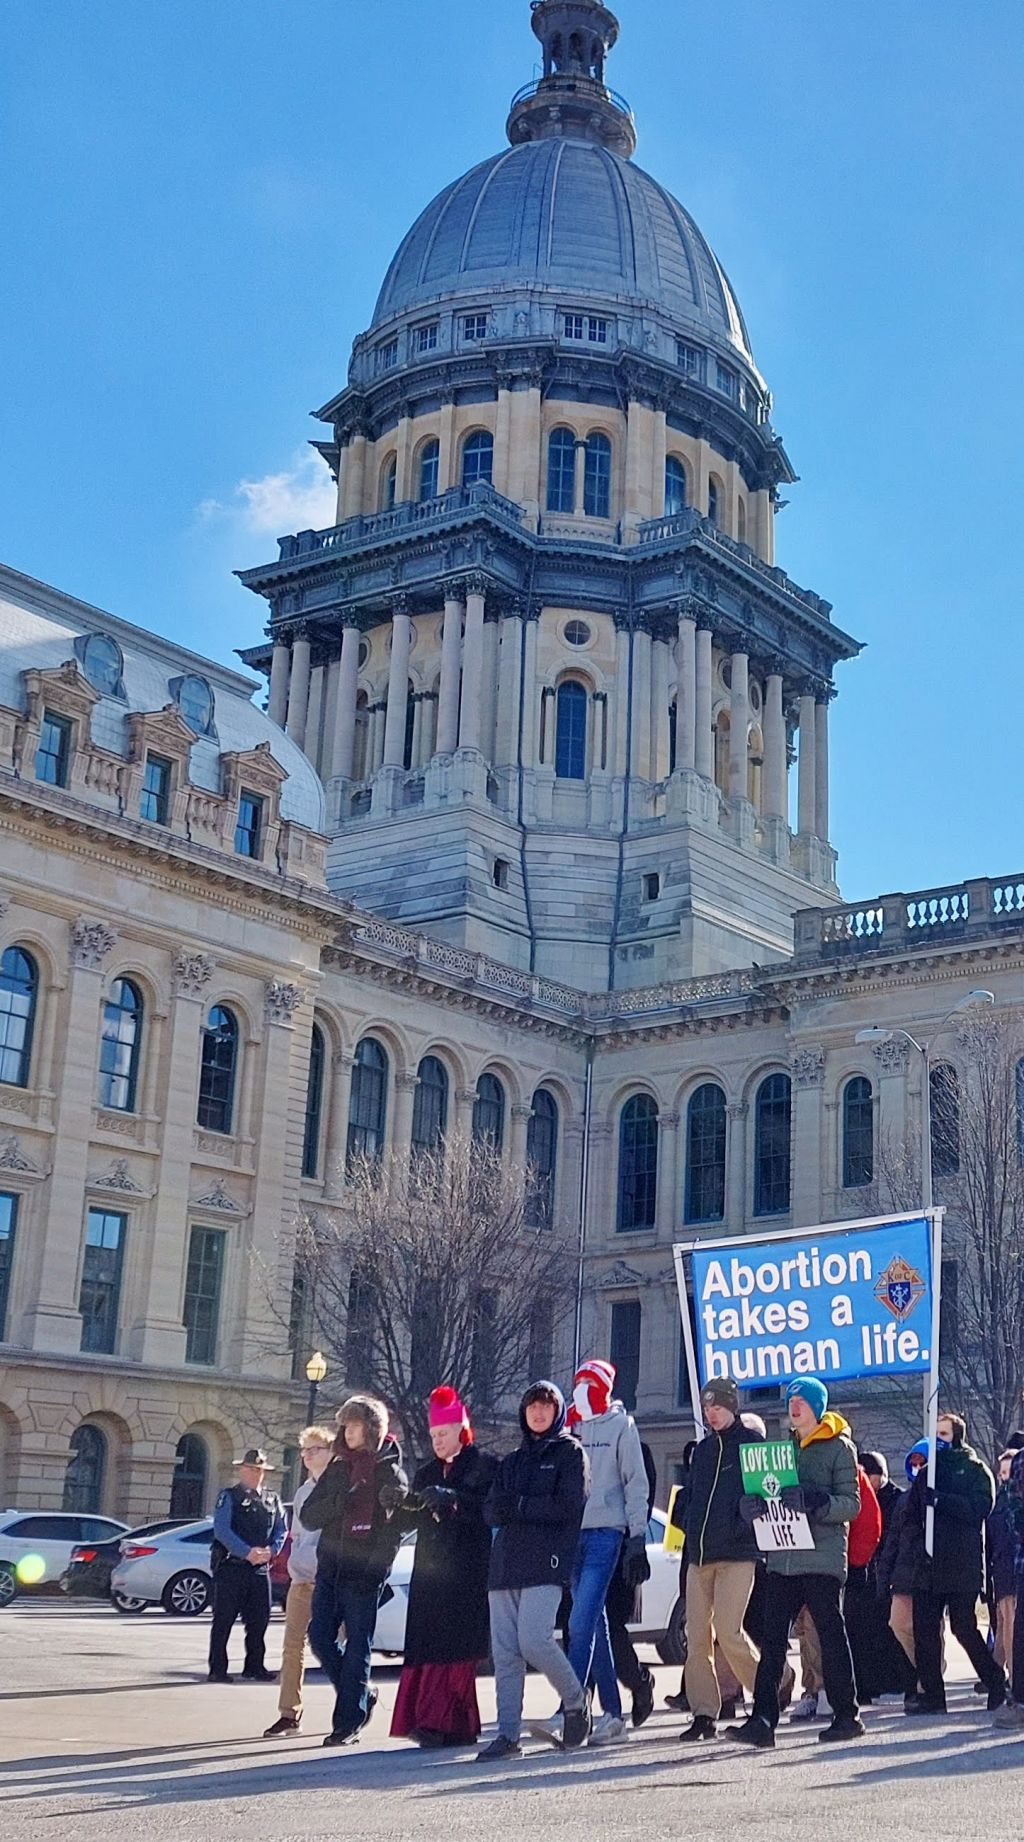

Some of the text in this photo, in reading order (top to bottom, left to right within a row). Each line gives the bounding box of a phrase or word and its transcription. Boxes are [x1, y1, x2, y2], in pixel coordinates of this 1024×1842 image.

[702, 1247, 872, 1301] Abortion
[702, 1294, 853, 1341] takes a
[704, 1323, 929, 1381] human life.
[742, 1444, 794, 1473] LOVE LIFE
[771, 1524, 796, 1547] LIFE
